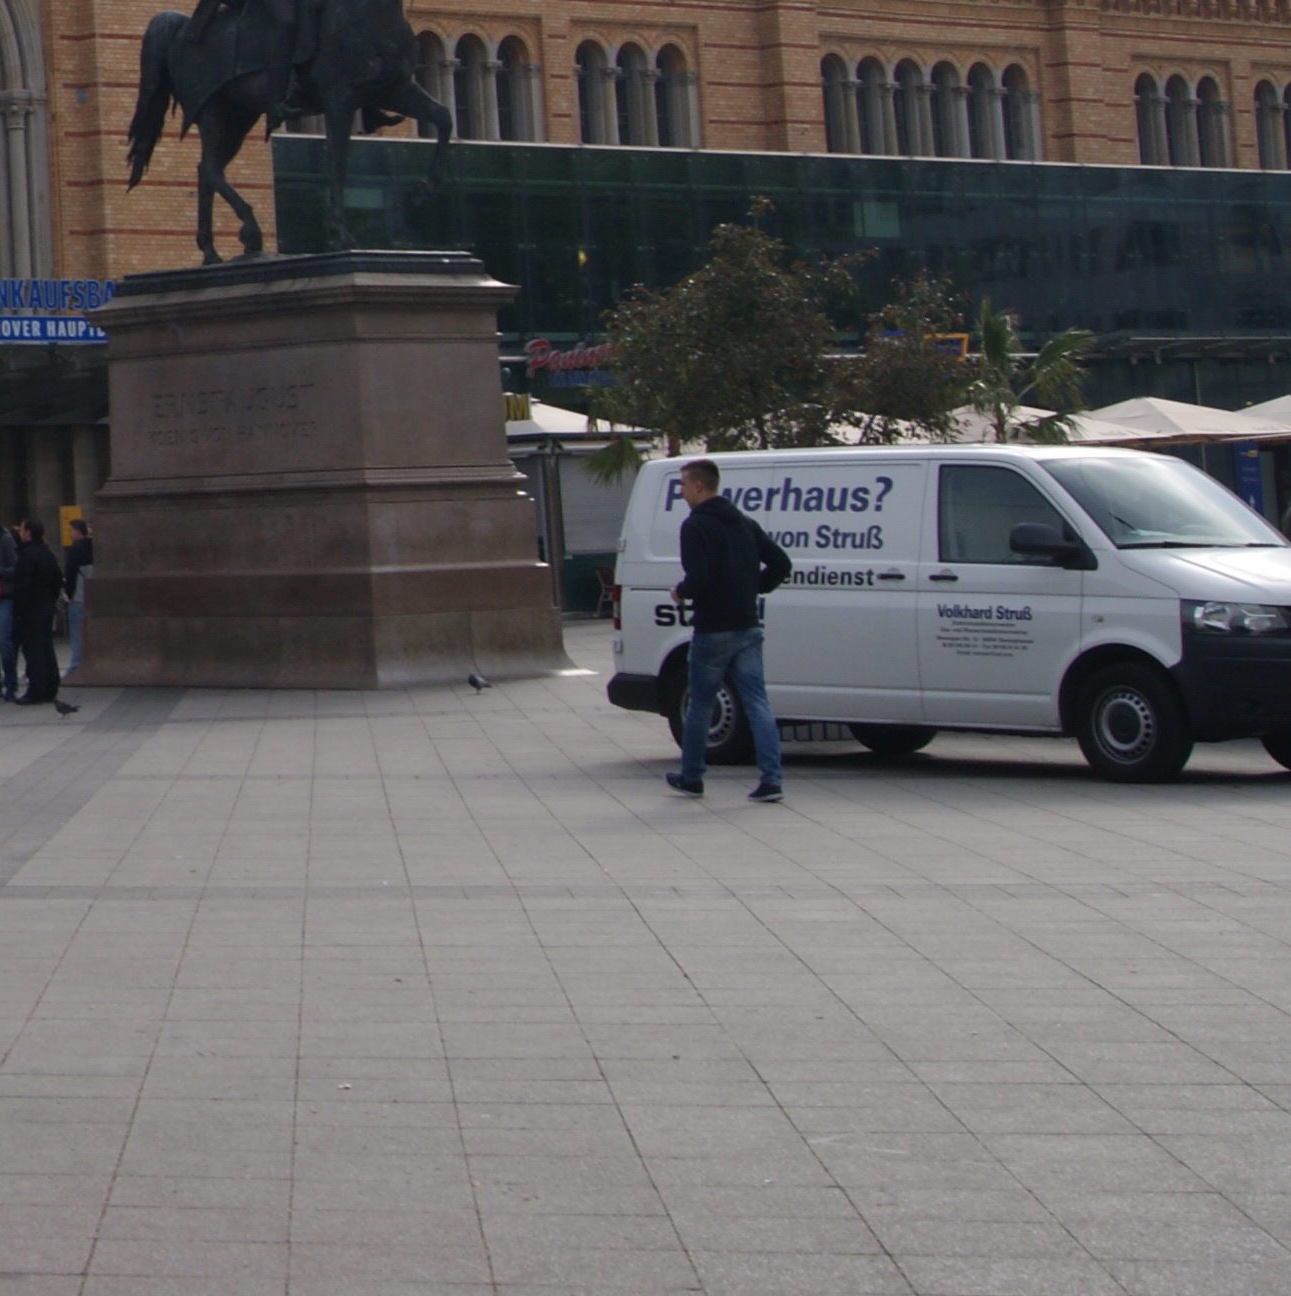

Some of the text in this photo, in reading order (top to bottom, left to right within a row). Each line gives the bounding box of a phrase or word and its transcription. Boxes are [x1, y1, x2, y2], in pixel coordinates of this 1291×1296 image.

[665, 476, 893, 512] Pwerhaus?
[815, 524, 883, 550] Struß
[937, 603, 1032, 621] Volkhard Struß
